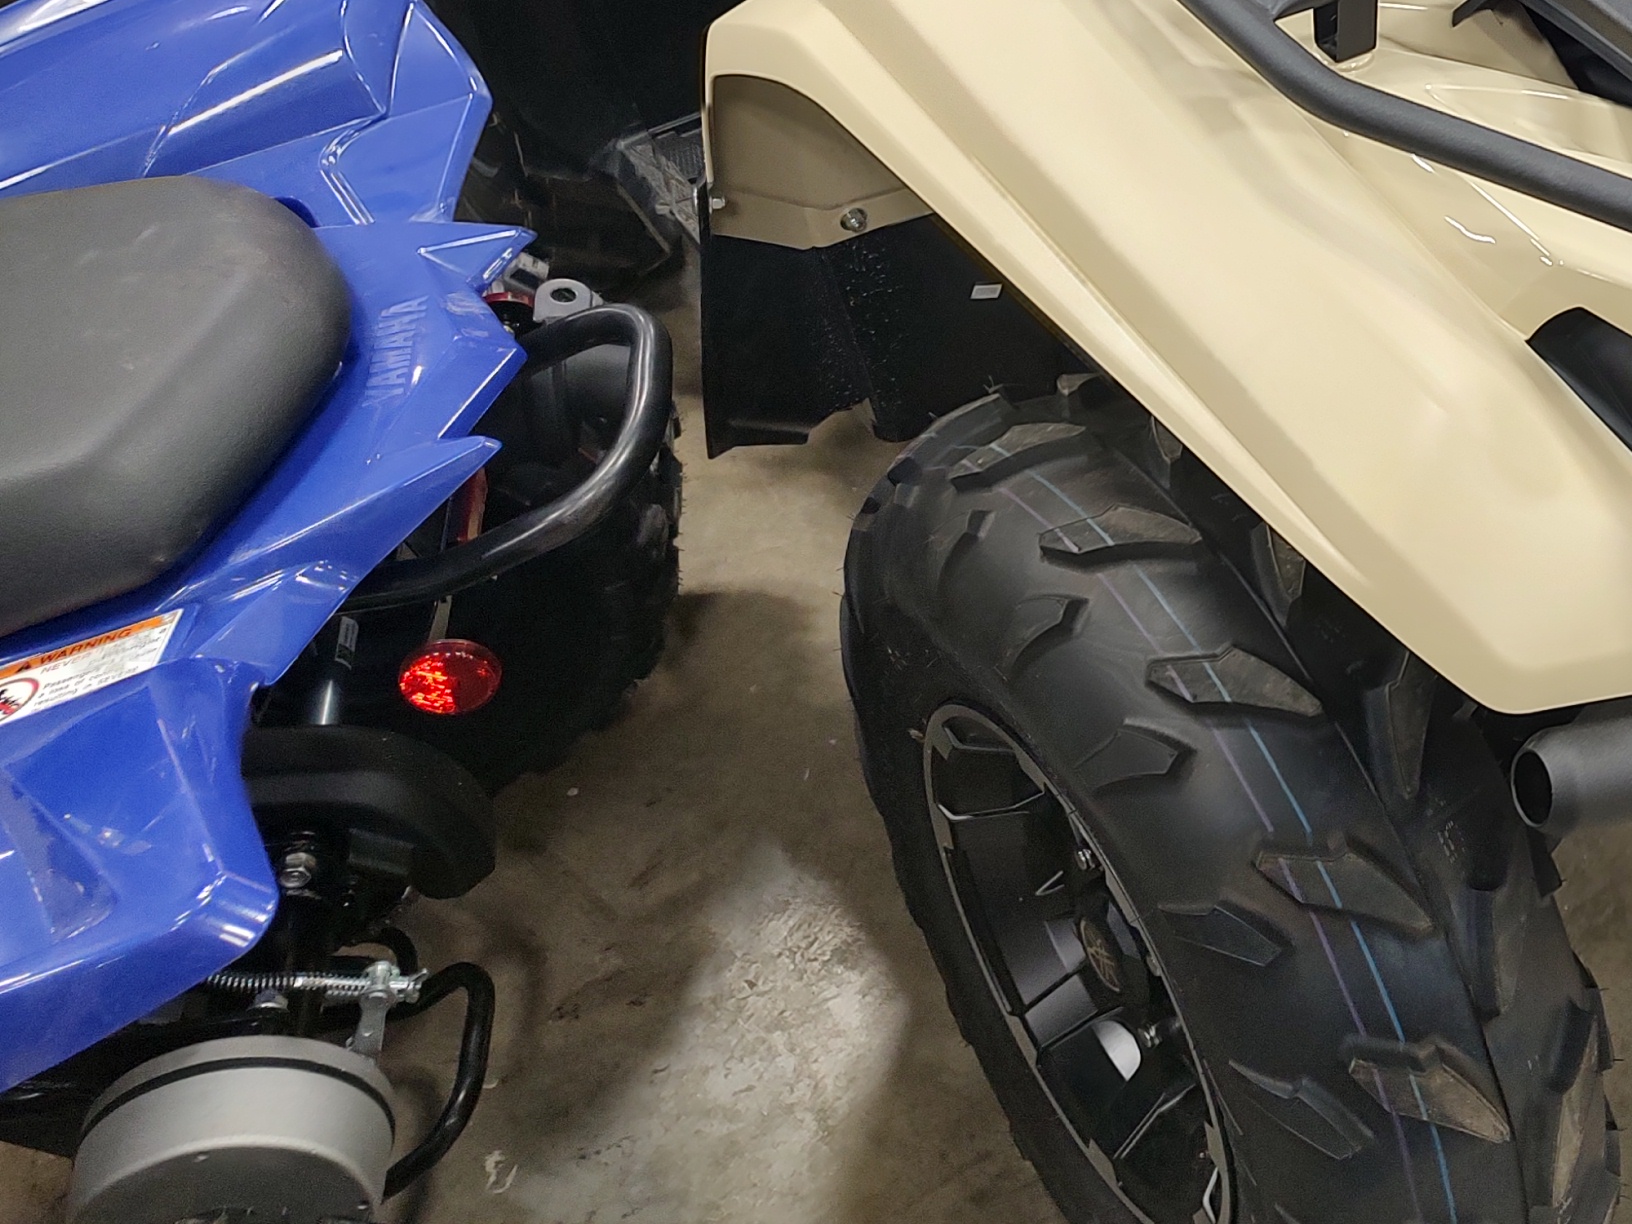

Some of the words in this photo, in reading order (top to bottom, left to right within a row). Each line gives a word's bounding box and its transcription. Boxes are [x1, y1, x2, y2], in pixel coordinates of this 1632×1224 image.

[362, 295, 430, 407] YAMAHA
[39, 628, 133, 664] WARNING
[40, 652, 92, 674] NEVER
